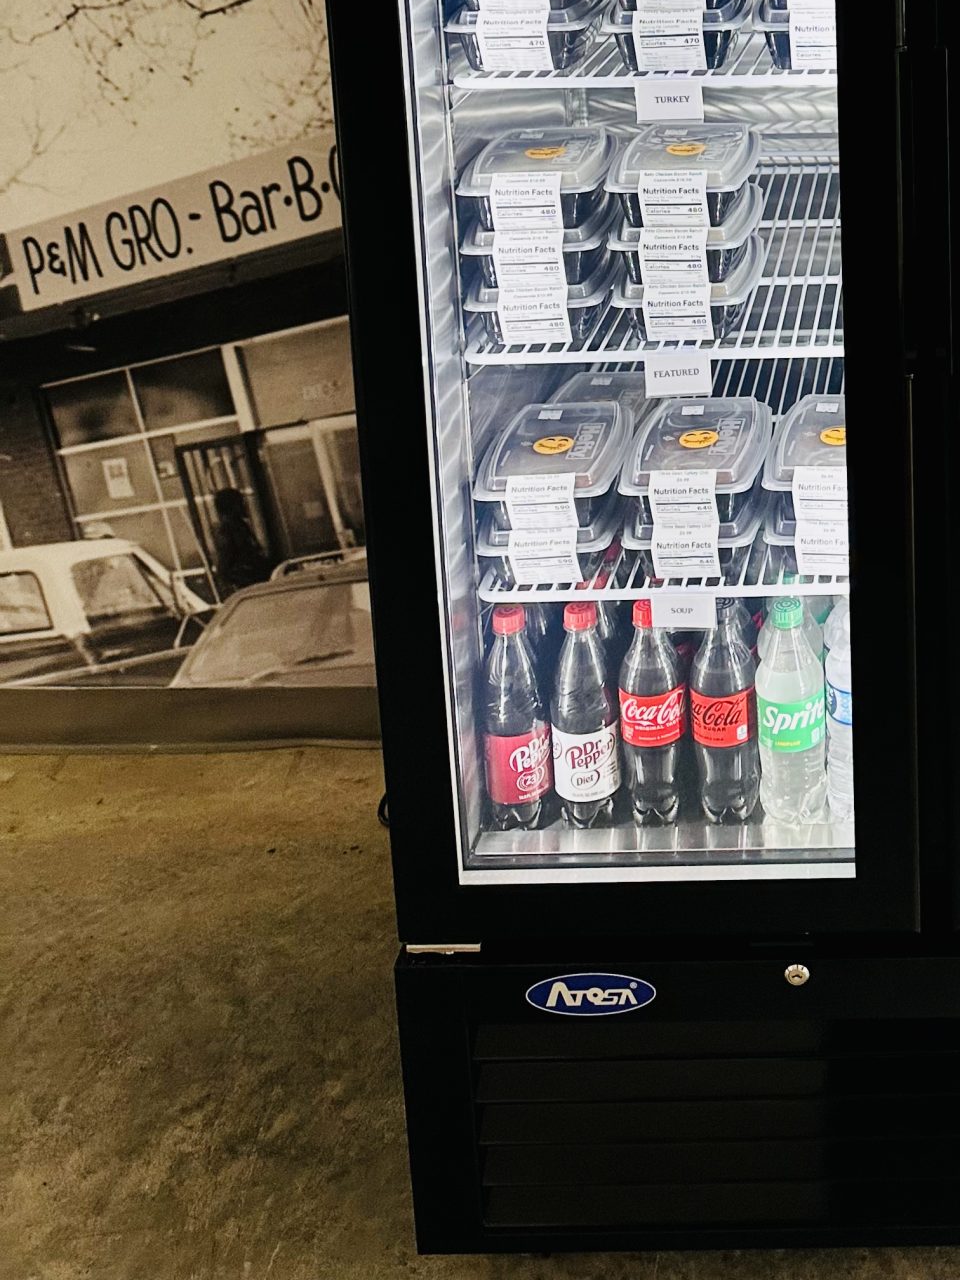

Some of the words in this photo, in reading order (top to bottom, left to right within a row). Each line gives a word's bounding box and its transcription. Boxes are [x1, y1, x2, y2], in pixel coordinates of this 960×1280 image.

[655, 96, 690, 104] TURKEY
[22, 222, 103, 295] P&M
[503, 304, 538, 312] Nutrition
[647, 300, 682, 308] Nutrition
[654, 369, 700, 378] FEATURED
[584, 739, 601, 753] Dr
[577, 774, 594, 786] Diet
